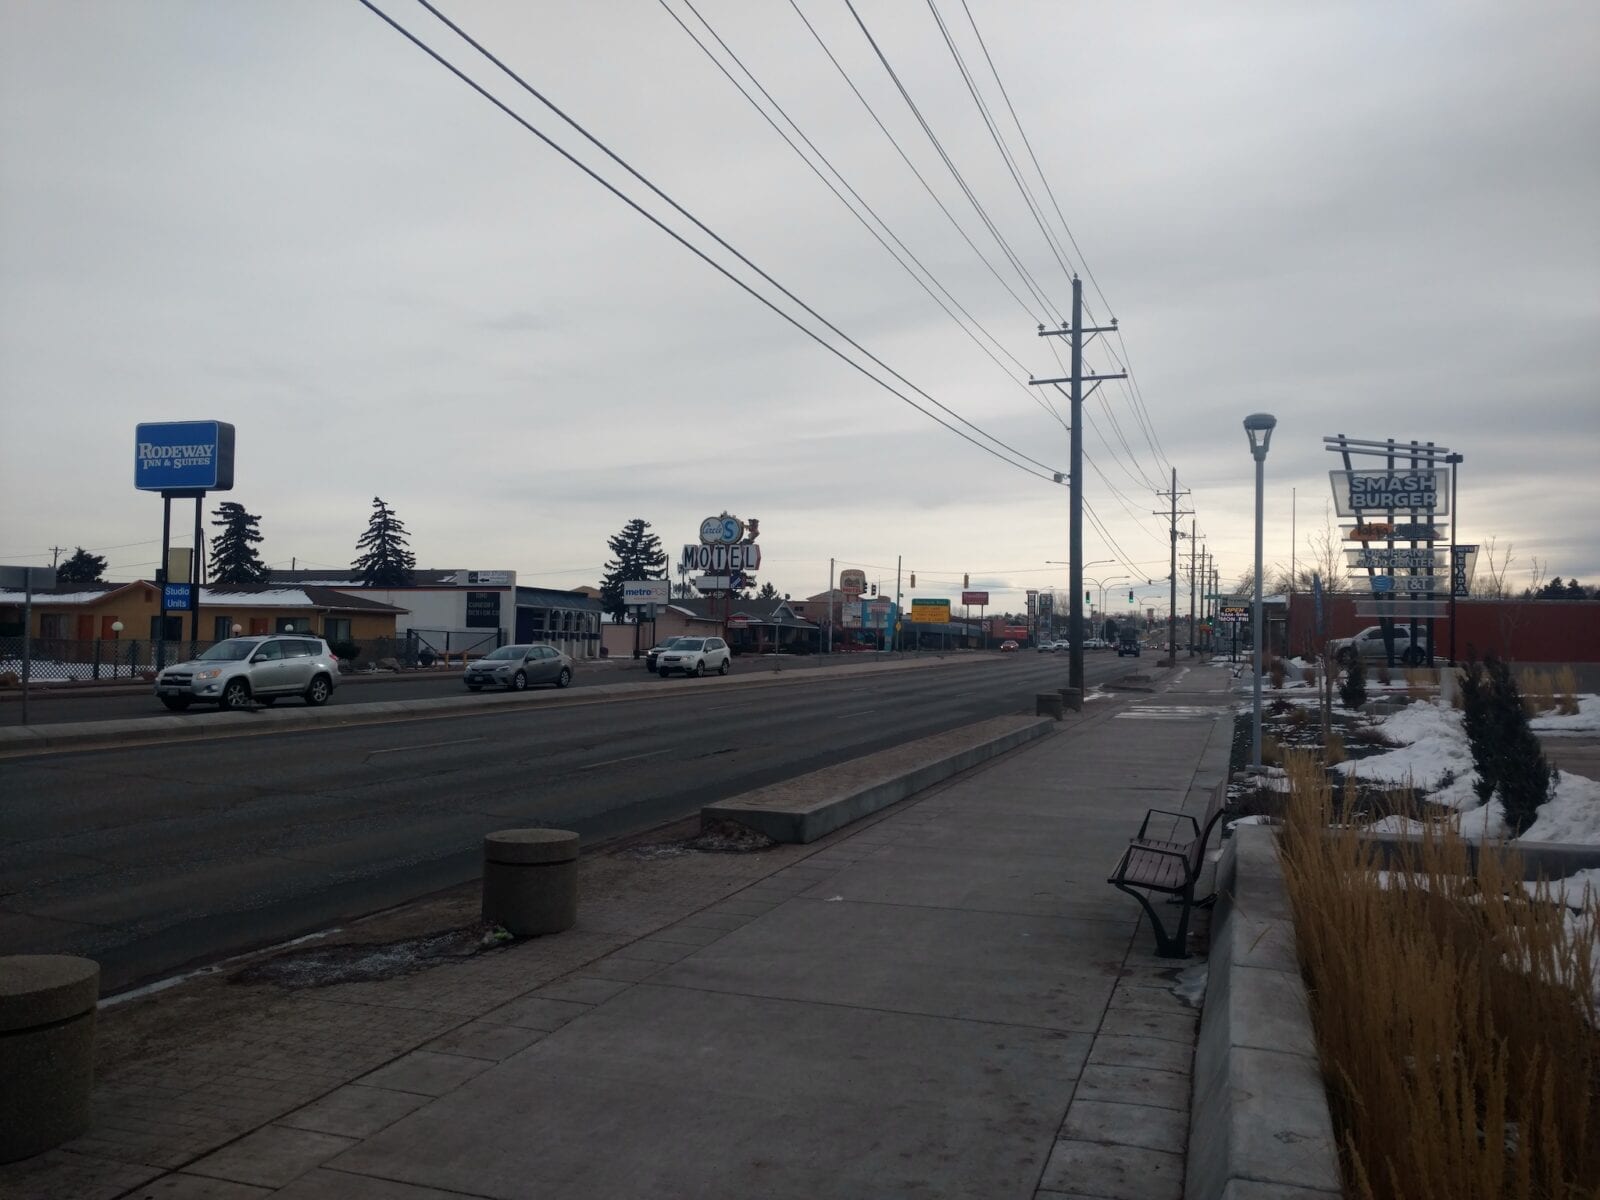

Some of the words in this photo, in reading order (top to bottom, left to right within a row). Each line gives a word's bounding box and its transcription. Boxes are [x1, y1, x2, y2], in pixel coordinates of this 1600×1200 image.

[138, 443, 215, 459] RODEWAY
[143, 459, 161, 469] INN
[163, 459, 171, 467] &
[173, 457, 211, 469] SUITES
[1352, 476, 1436, 492] SMASH
[1351, 492, 1437, 507] BURGER
[724, 520, 734, 539] S
[684, 546, 755, 568] MOTEL
[1389, 558, 1435, 568] CENTER
[1457, 552, 1465, 591] NEVADA
[165, 586, 190, 596] Studio
[1393, 579, 1429, 590] AT&T
[167, 599, 187, 608] Units
